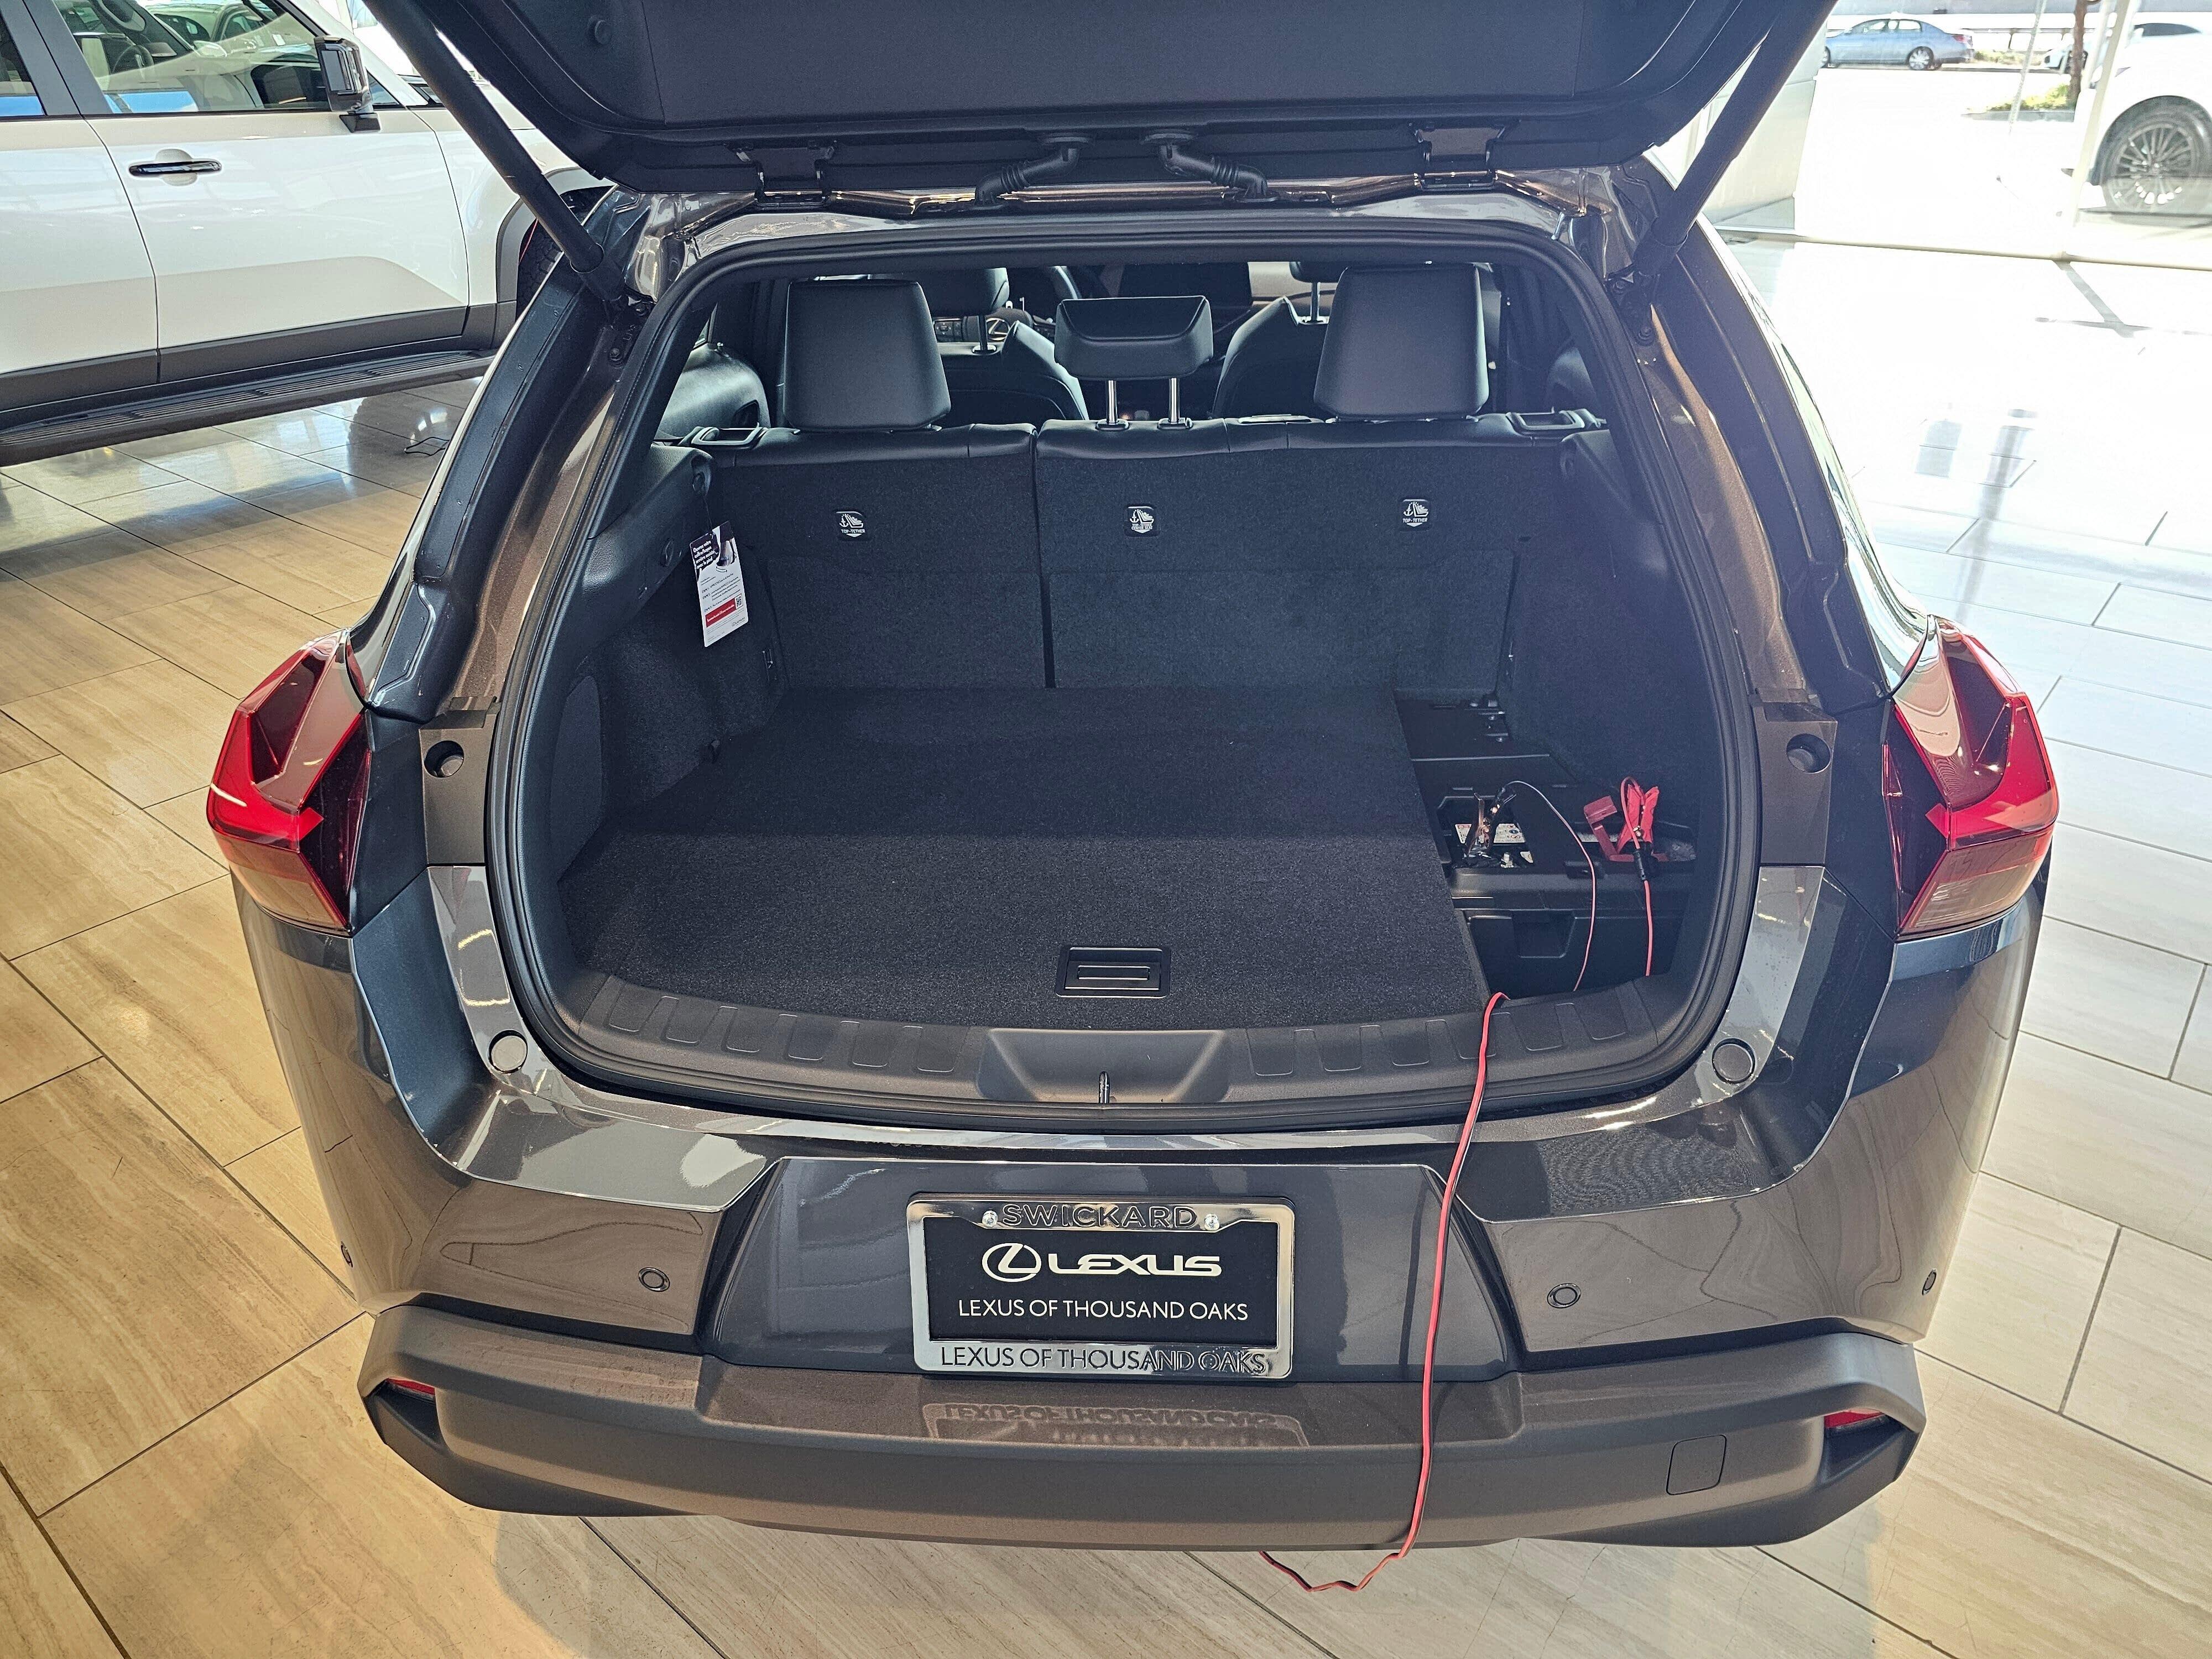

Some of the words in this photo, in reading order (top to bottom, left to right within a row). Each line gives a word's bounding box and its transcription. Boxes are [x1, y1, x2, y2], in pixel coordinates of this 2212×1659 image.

[1002, 1203, 1198, 1229] SWICKARD
[1048, 1253, 1222, 1277] LEXUS
[958, 1299, 1025, 1317] LEXUS
[1029, 1300, 1058, 1317] OF
[1062, 1300, 1185, 1318] THOUSAND
[1190, 1302, 1249, 1321] OAKS
[941, 1347, 1015, 1367] LEXUS
[1020, 1348, 1053, 1368] OF
[1057, 1349, 1195, 1371] THOUSAND
[1198, 1350, 1269, 1376] OAKS
